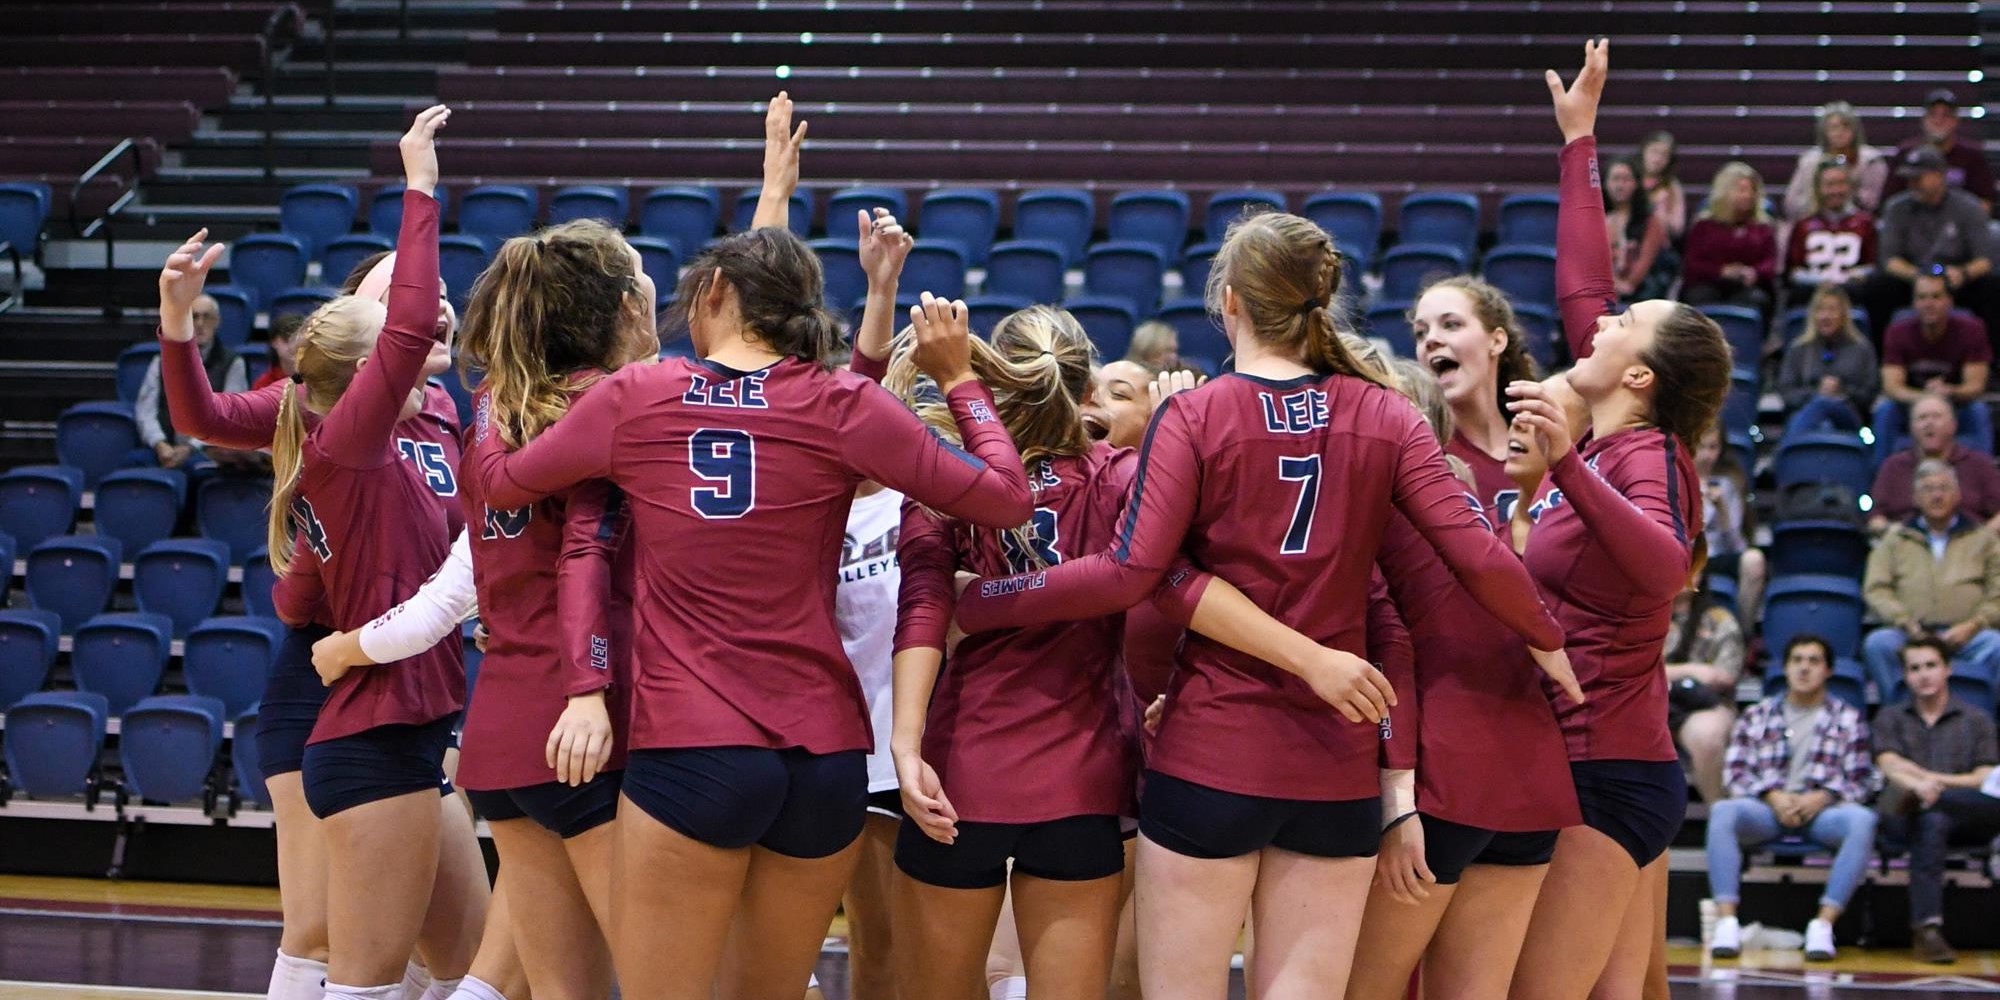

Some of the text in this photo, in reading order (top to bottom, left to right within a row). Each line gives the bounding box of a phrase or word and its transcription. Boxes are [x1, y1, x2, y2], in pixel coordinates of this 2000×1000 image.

[682, 369, 770, 409] LEE
[967, 399, 995, 424] LEE
[1259, 388, 1330, 433] LEE
[688, 427, 755, 519] 9
[1278, 453, 1322, 554] 7
[981, 571, 1046, 598] FLAMES
[591, 634, 608, 669] LEE
